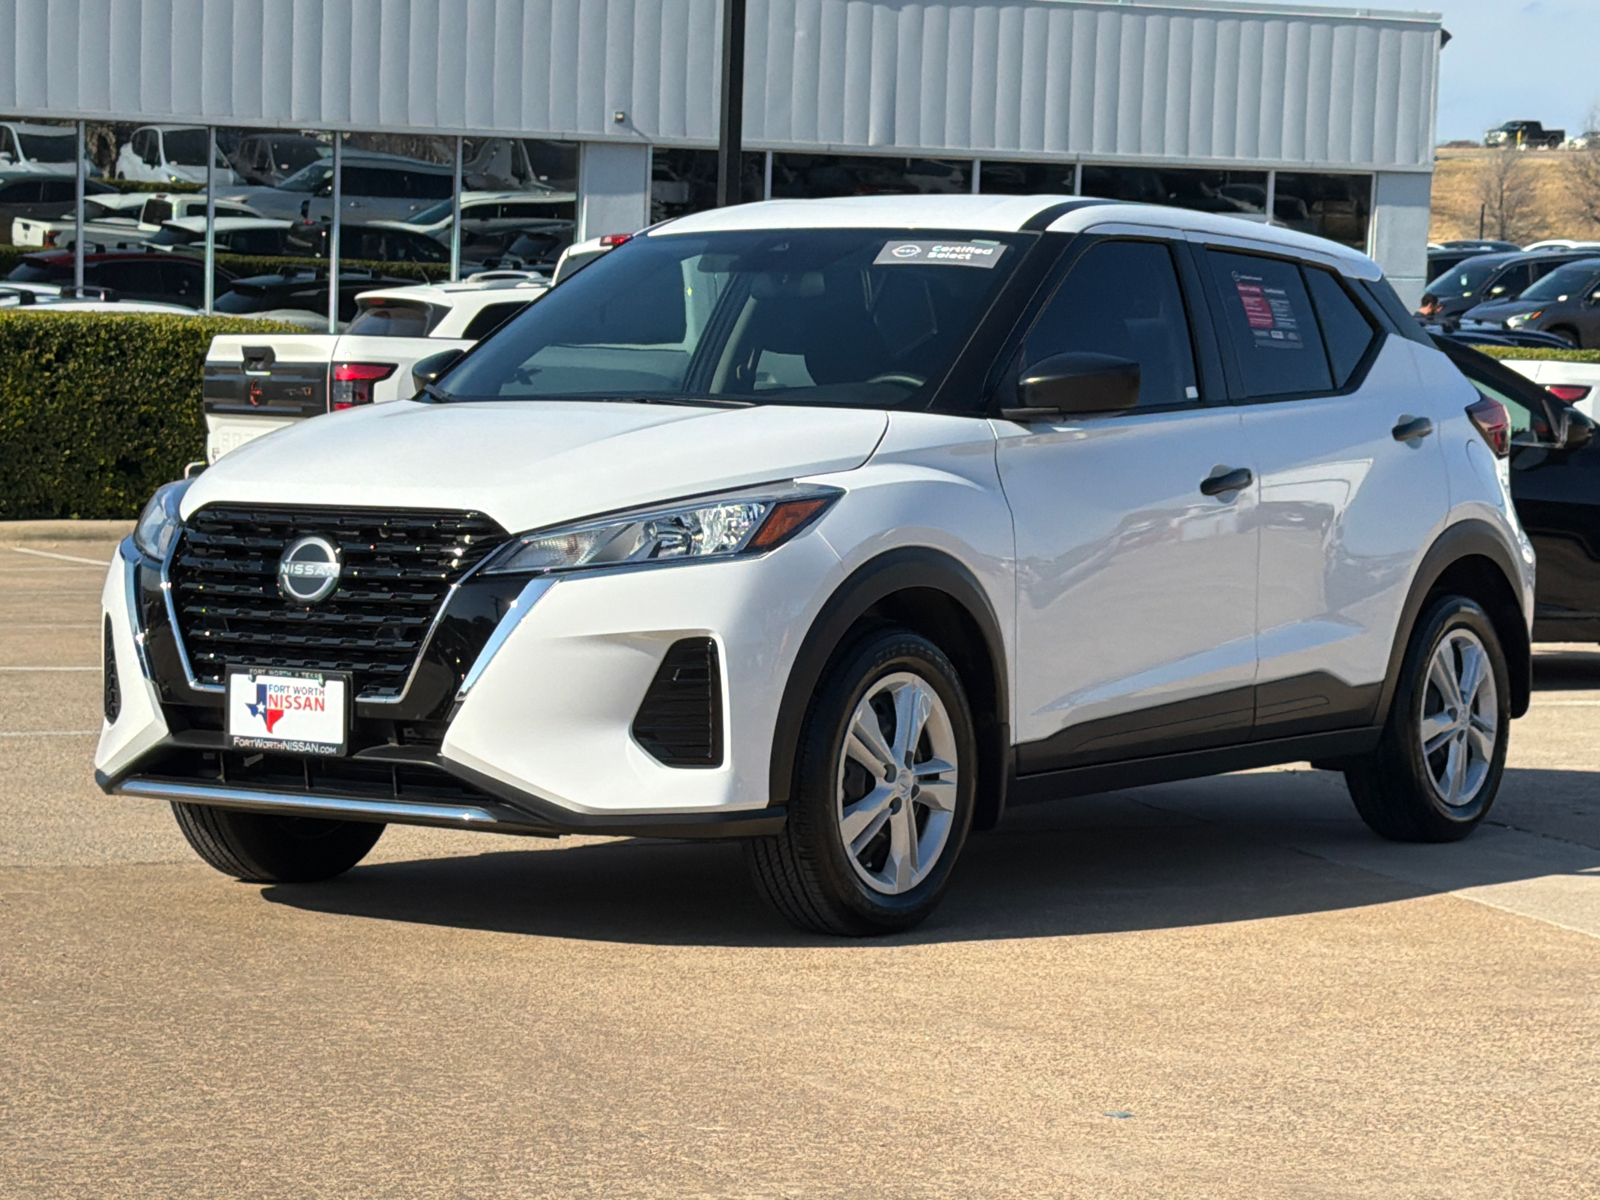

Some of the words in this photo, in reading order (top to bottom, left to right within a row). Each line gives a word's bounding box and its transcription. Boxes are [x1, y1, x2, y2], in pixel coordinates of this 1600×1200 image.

[927, 252, 972, 260] Select
[931, 245, 994, 255] Certified
[280, 563, 338, 576] NISSAN
[268, 684, 290, 693] FORT
[293, 686, 325, 696] WORTH
[268, 694, 325, 712] NISSAN
